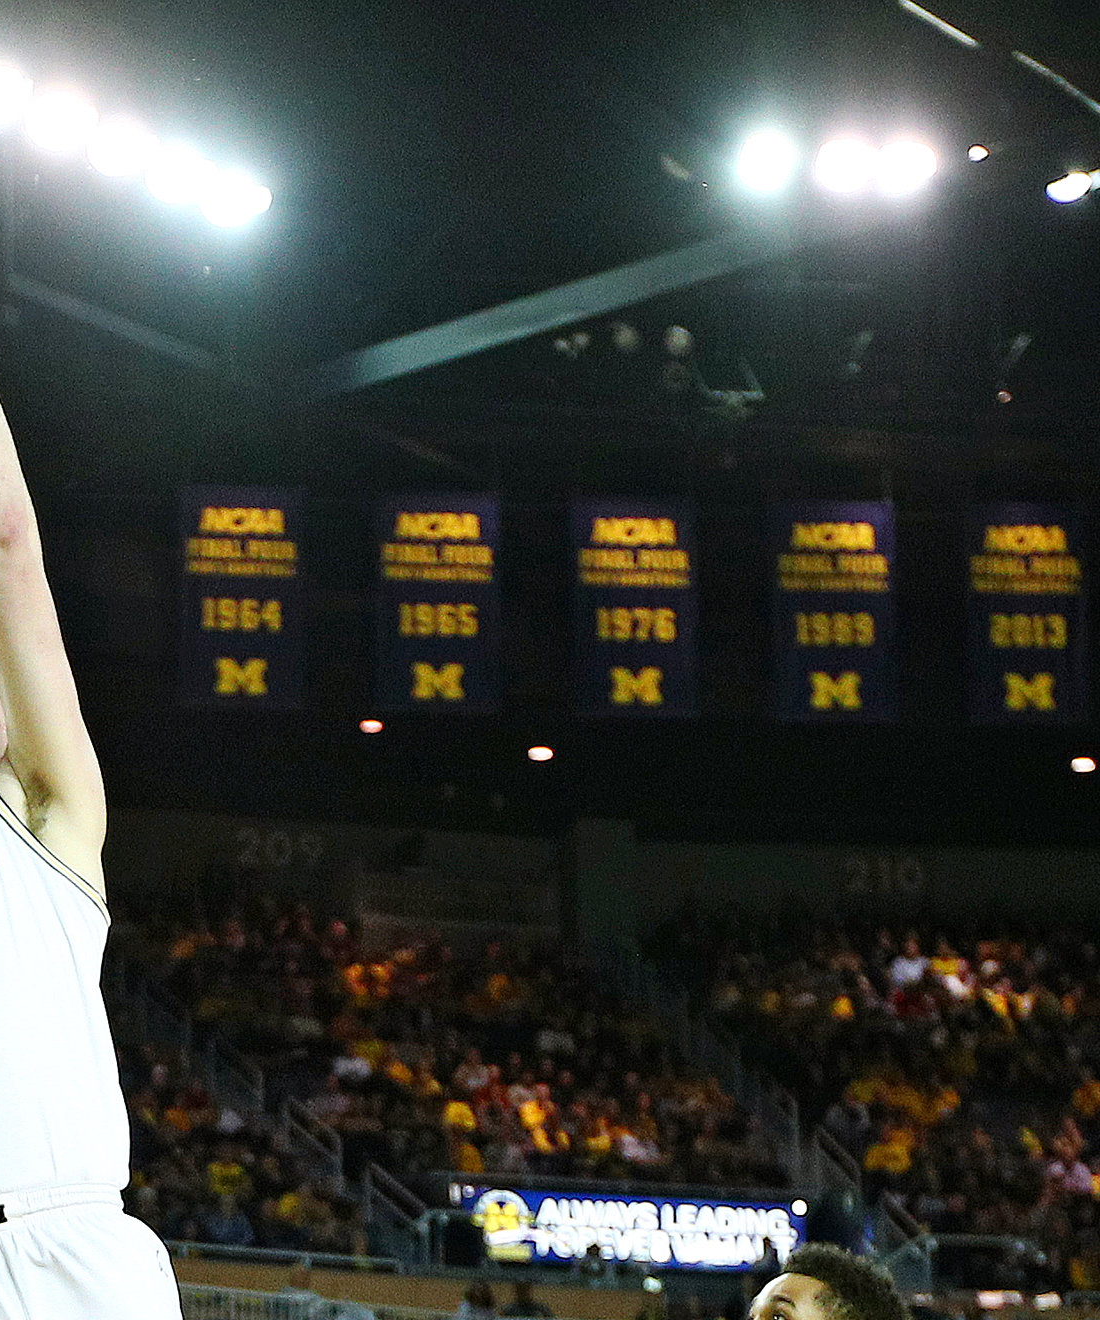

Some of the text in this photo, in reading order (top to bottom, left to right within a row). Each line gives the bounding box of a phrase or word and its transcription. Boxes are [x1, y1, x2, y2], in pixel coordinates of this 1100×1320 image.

[202, 599, 282, 633] 1964
[400, 603, 479, 637] 1965
[596, 606, 677, 642] 1976
[214, 657, 268, 696] M
[411, 662, 464, 700] M
[610, 666, 663, 706] M
[810, 671, 862, 709] M
[1003, 672, 1056, 710] M
[536, 1197, 659, 1230] ALWAYS
